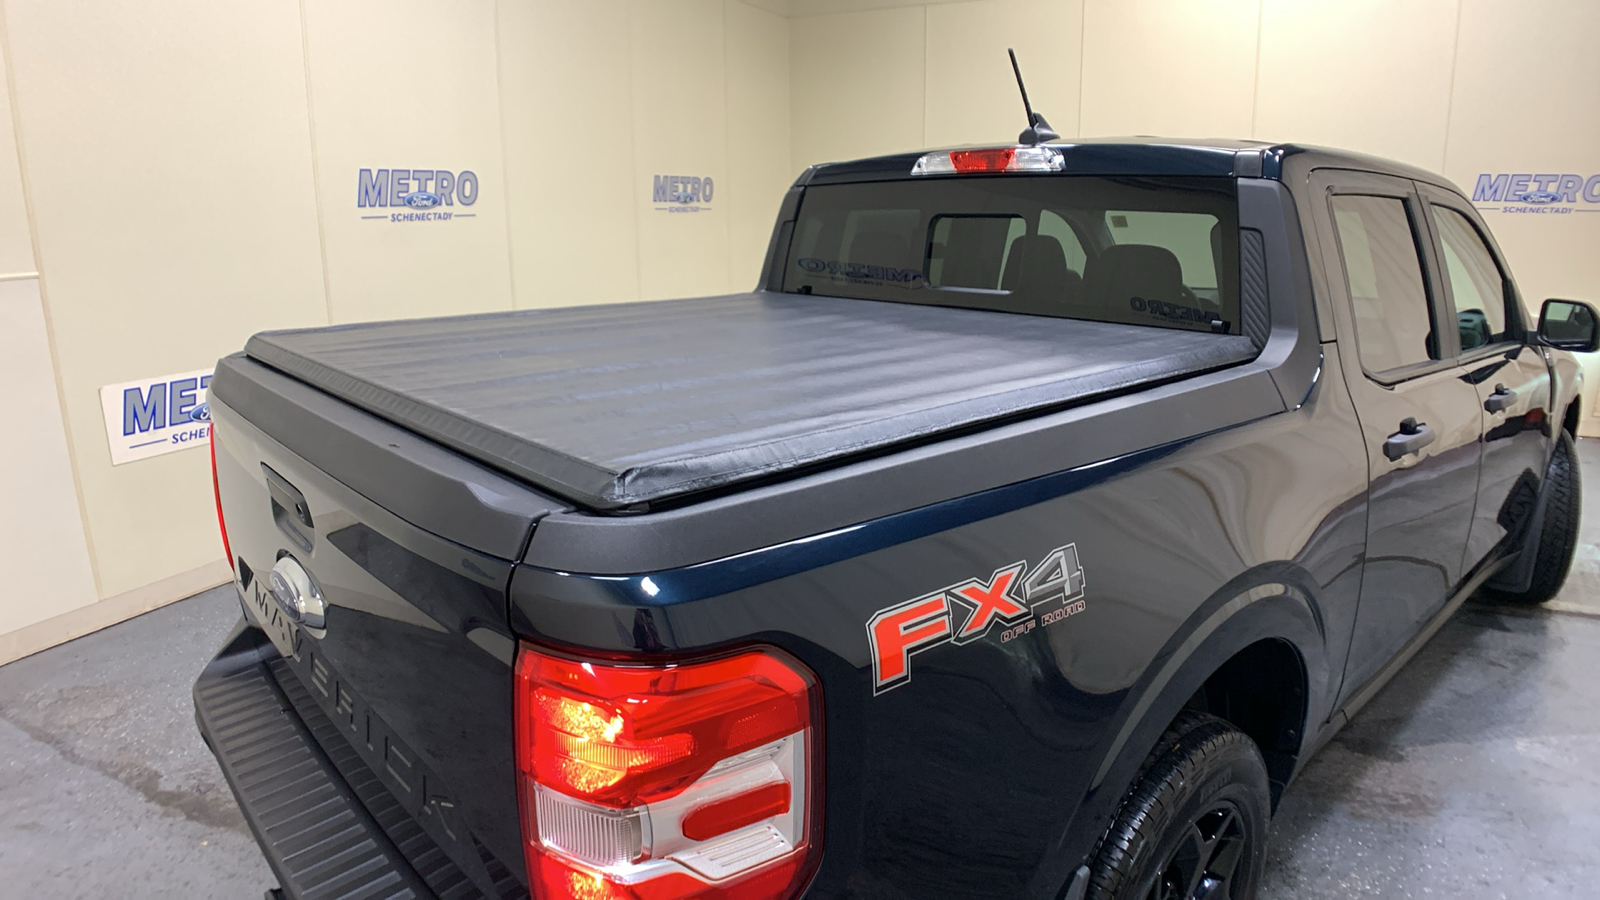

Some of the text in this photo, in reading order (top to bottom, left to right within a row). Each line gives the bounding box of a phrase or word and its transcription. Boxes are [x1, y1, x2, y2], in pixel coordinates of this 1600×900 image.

[357, 168, 479, 208] METRO
[411, 194, 433, 206] Ford
[653, 175, 714, 203] METRO
[1472, 174, 1600, 204] METRO
[390, 212, 453, 222] SCHENECTADY
[1502, 206, 1574, 214] SCHENECTADY
[866, 542, 1086, 697] FX4
[1000, 600, 1086, 643] OFF ROAD
[253, 578, 457, 841] MAVERICK
